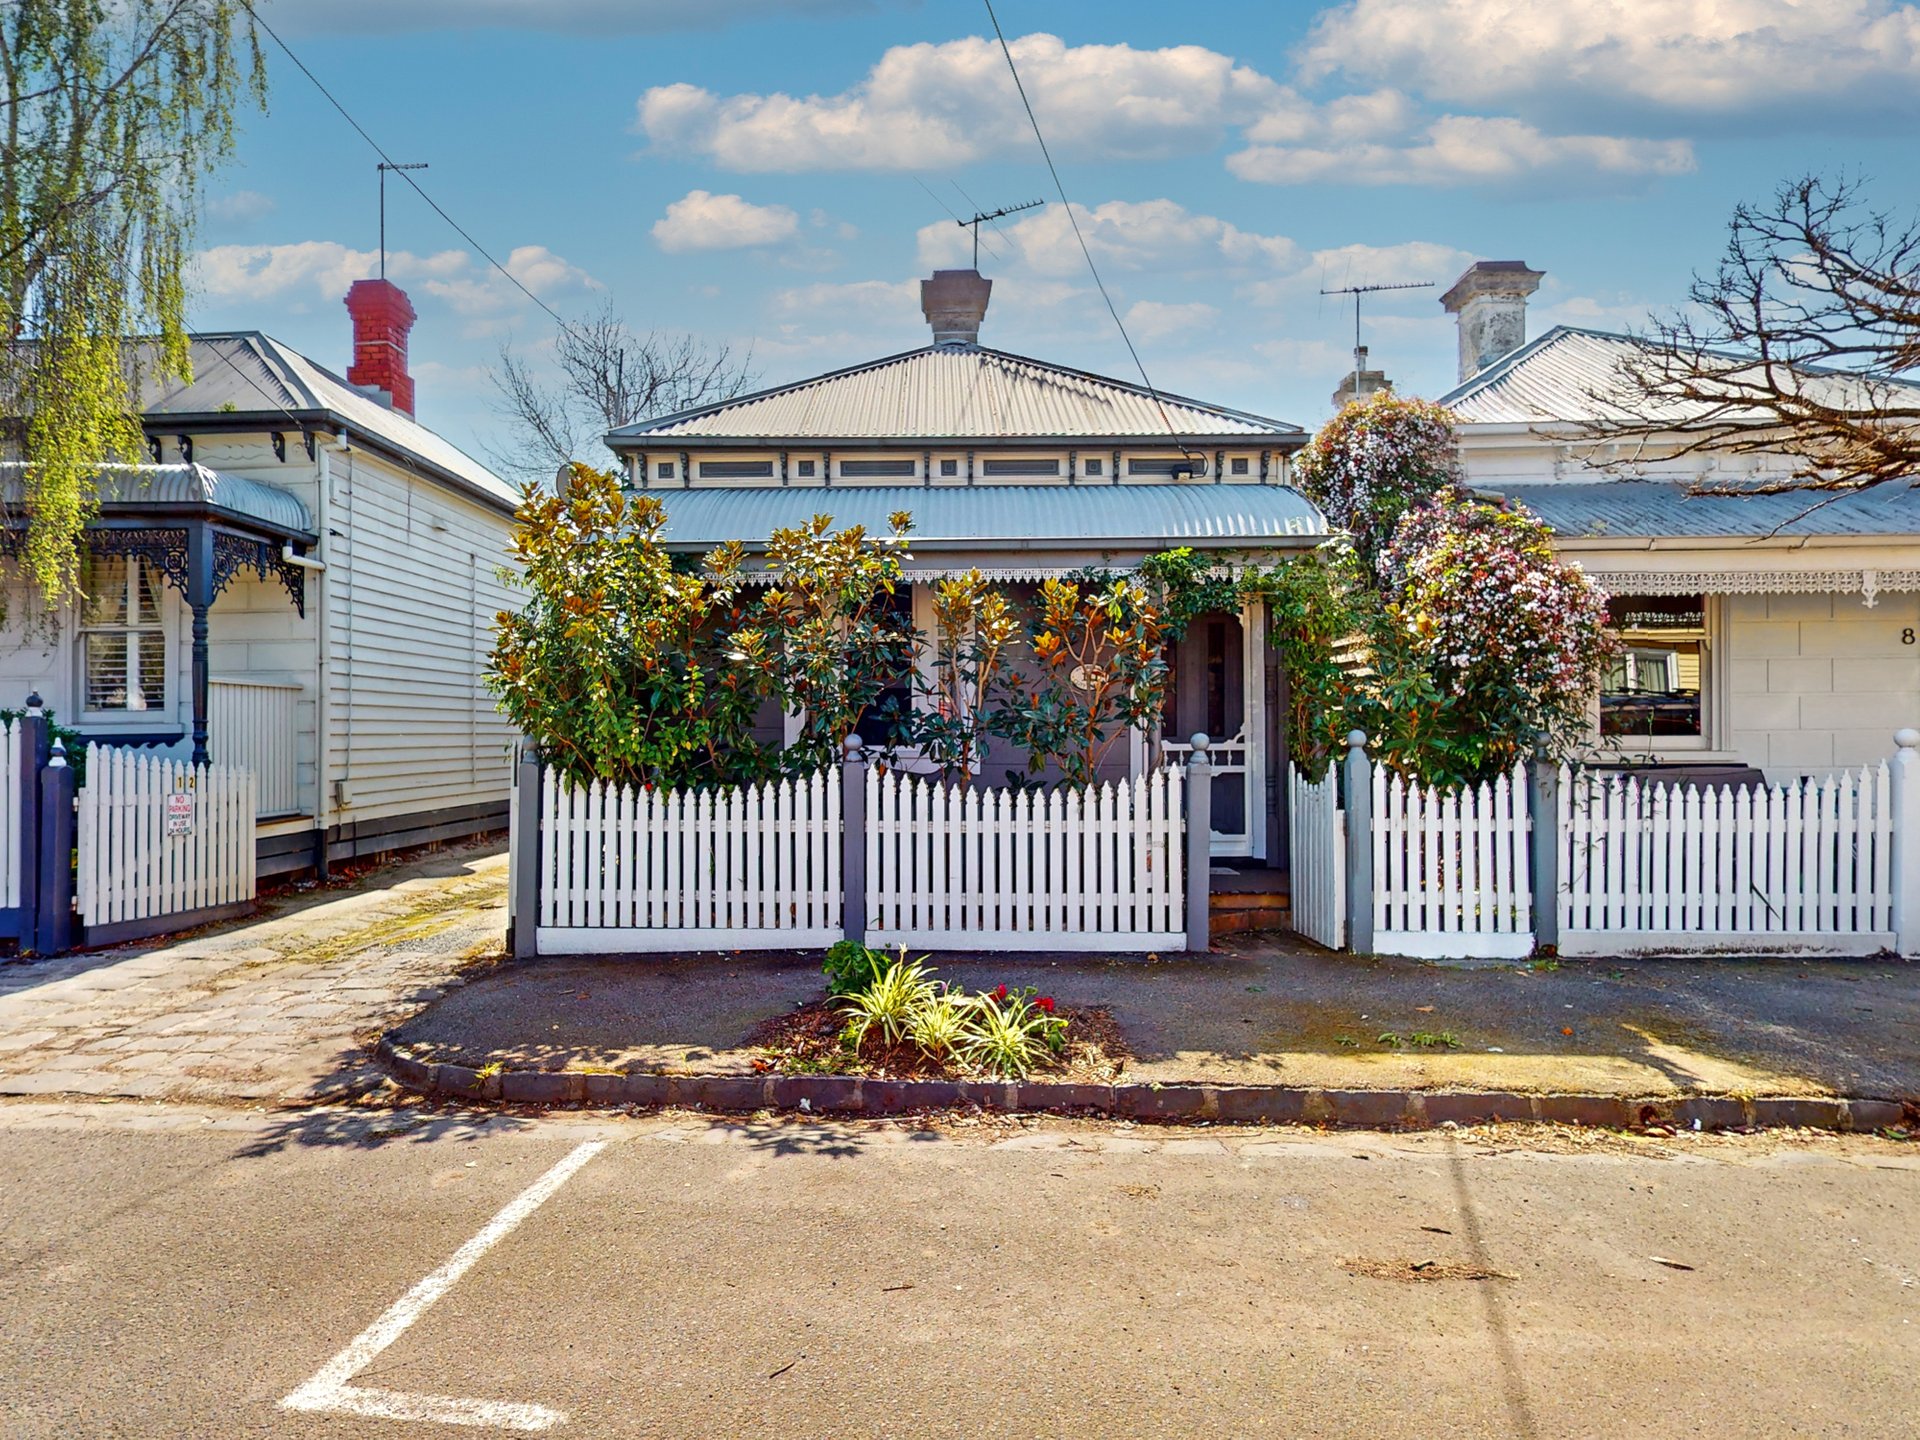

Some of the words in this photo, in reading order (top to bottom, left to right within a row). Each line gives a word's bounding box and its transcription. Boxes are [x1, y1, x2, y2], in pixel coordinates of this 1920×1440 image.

[1902, 628, 1915, 645] 8
[175, 795, 185, 804] NO
[168, 804, 191, 813] PARKING
